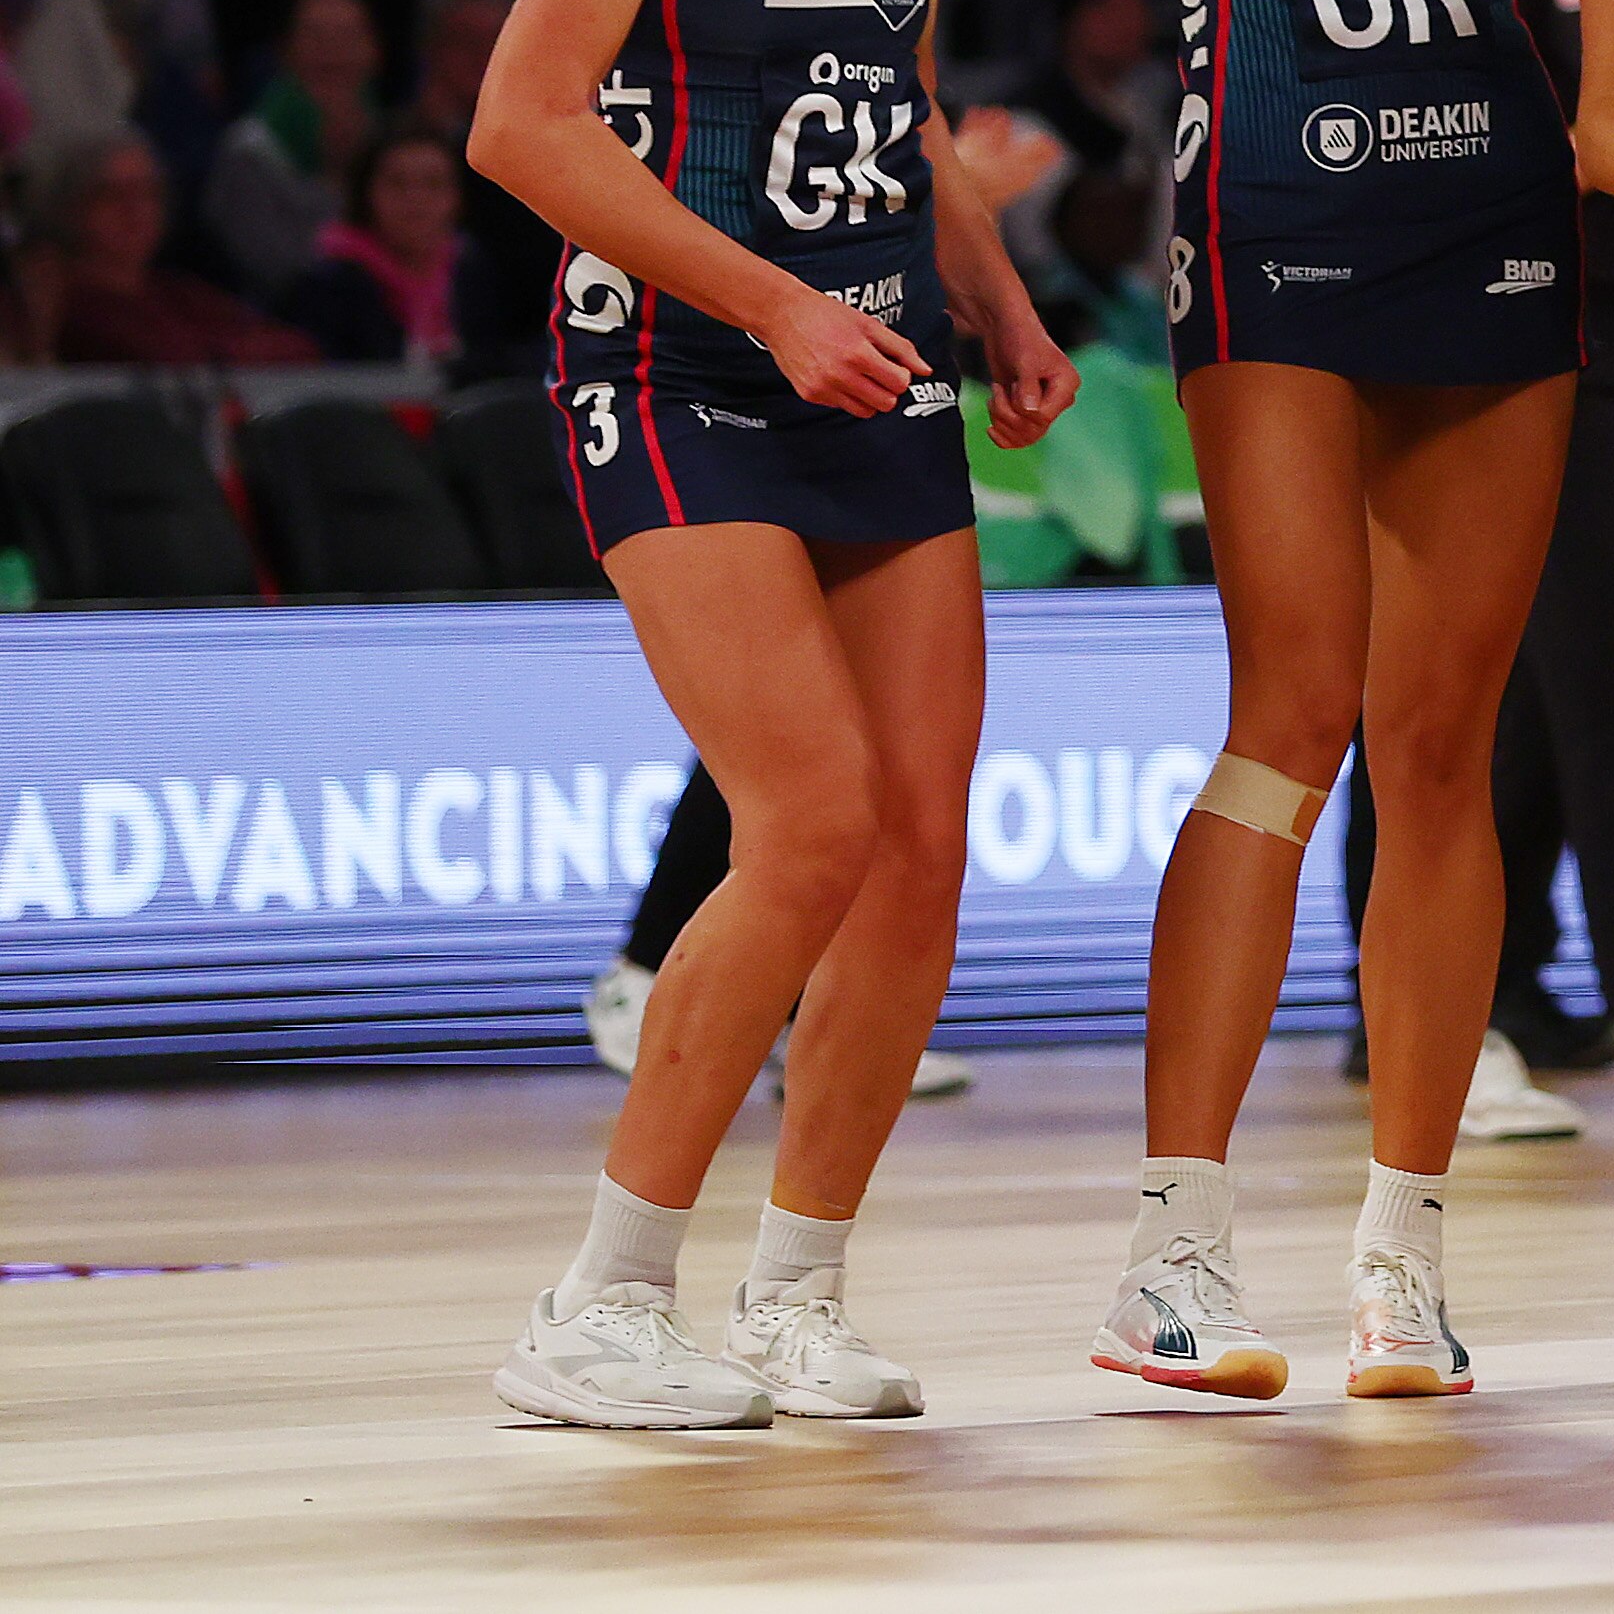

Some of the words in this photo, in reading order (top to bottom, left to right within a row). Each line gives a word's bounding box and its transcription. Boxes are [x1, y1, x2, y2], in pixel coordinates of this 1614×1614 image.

[844, 57, 895, 93] origin
[1378, 101, 1489, 140] DEAKIN
[765, 93, 912, 231] GK
[1380, 136, 1491, 162] UNIVERSITY
[1504, 259, 1556, 281] BMD
[908, 382, 956, 403] BMD
[572, 382, 620, 466] 3
[0, 758, 690, 921] ADVANCING
